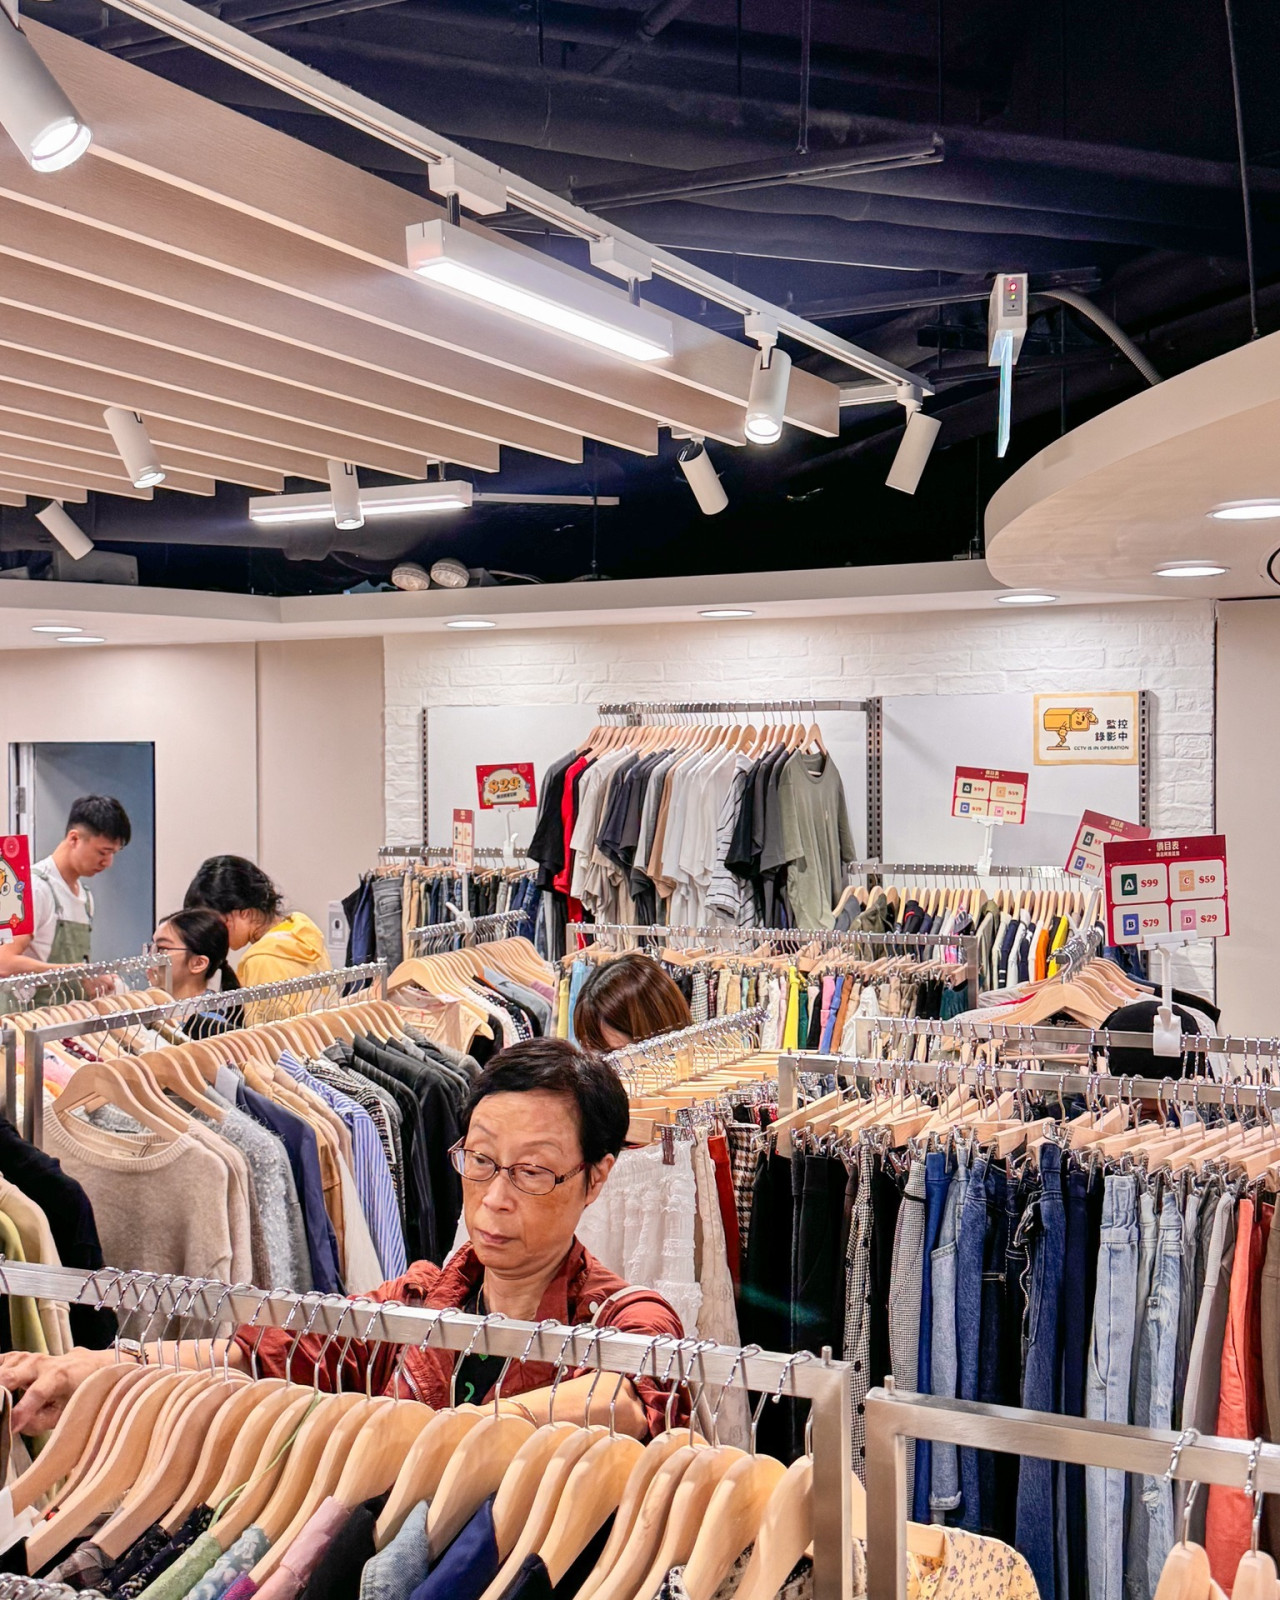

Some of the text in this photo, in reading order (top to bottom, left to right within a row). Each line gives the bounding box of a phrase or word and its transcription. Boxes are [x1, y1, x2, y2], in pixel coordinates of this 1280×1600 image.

[1106, 719, 1128, 729] 監控
[1095, 731, 1128, 741] 錄影中
[1156, 841, 1180, 851] 價目表
[1140, 878, 1158, 888] $99
[1198, 874, 1216, 884] $59
[1142, 918, 1160, 928] $79
[1200, 914, 1218, 924] $29
